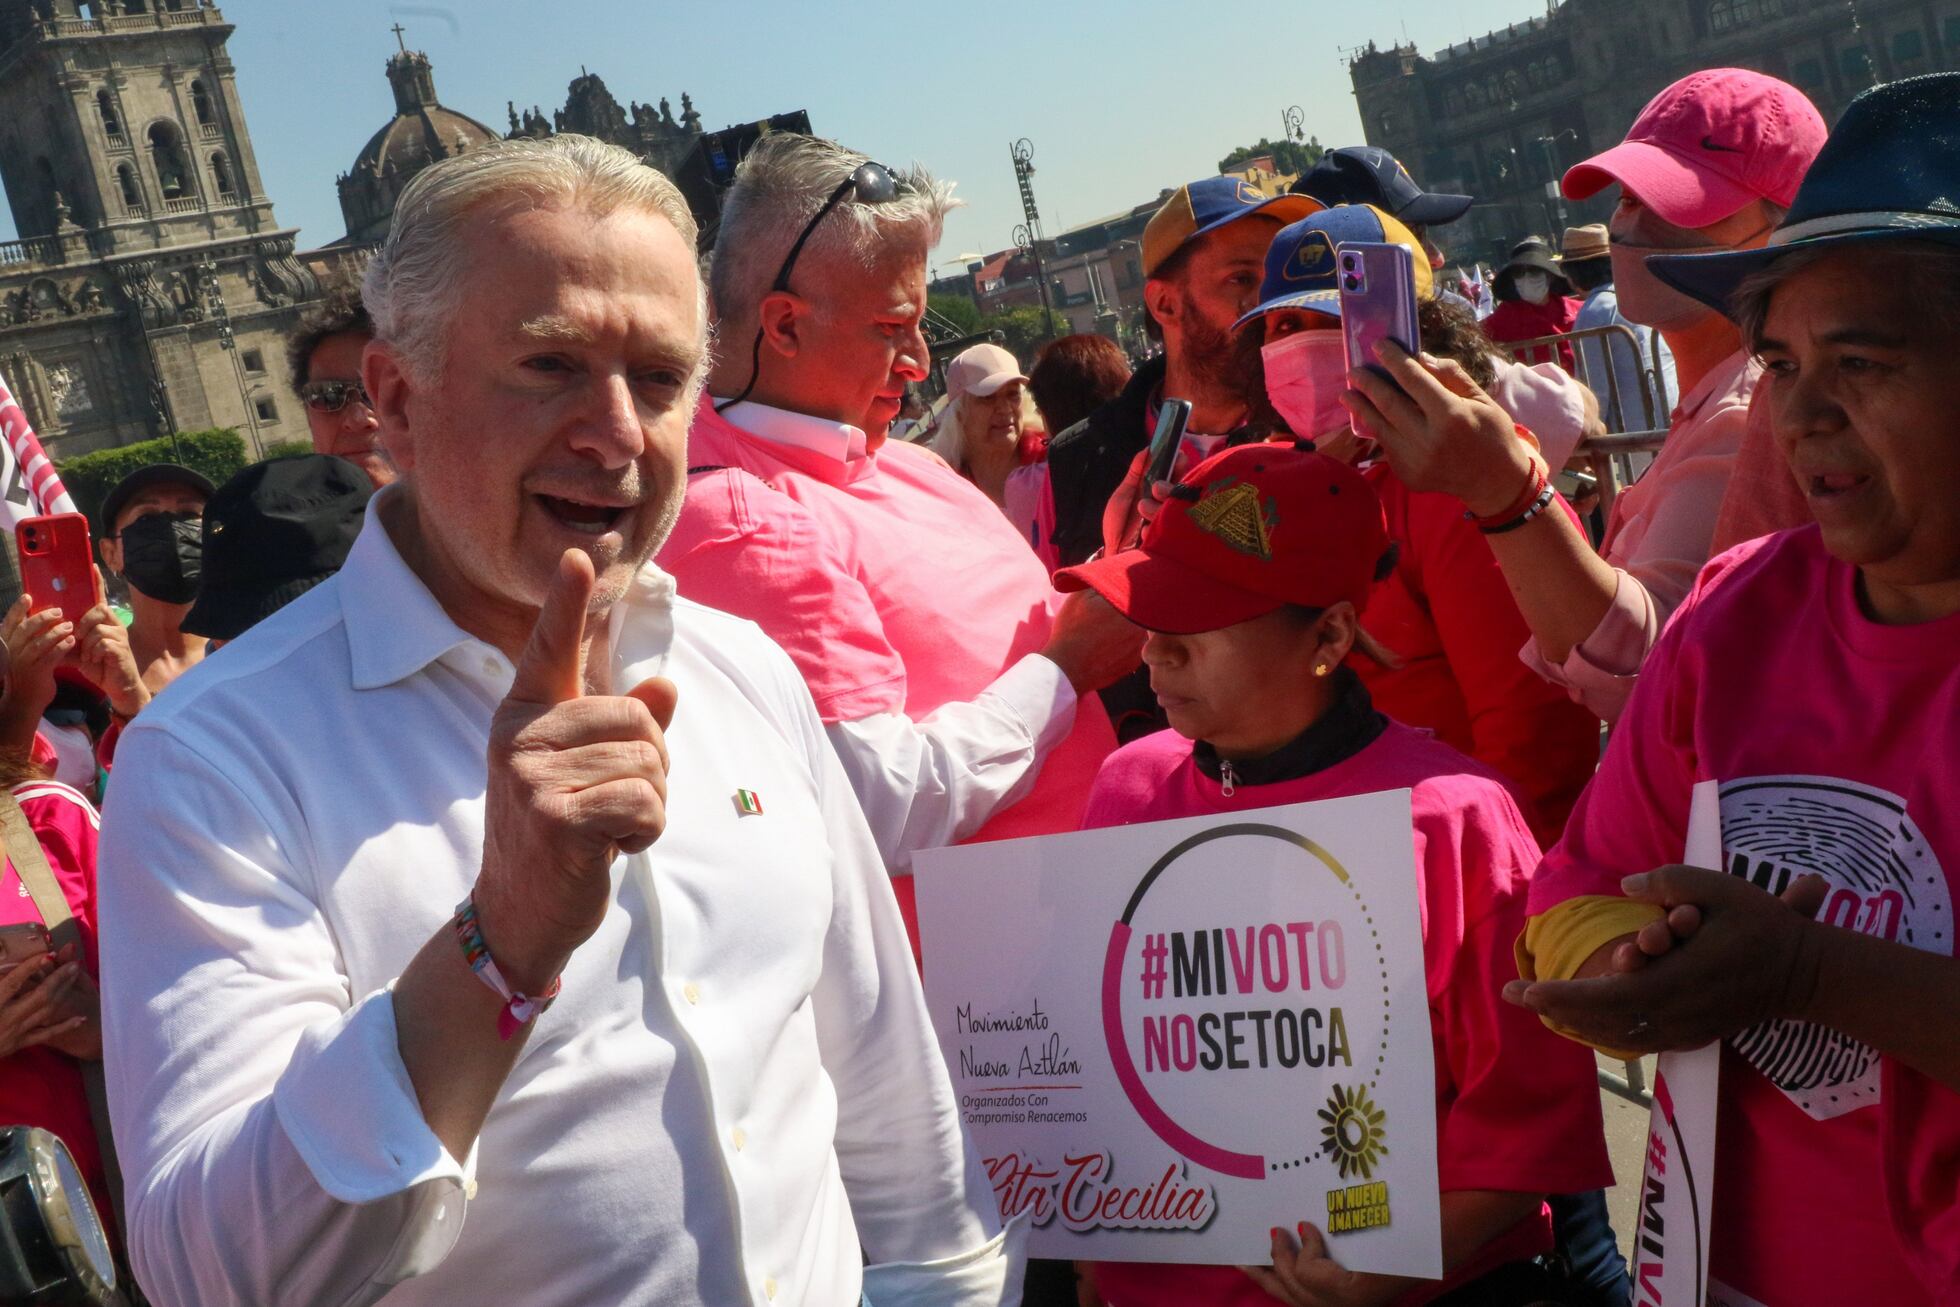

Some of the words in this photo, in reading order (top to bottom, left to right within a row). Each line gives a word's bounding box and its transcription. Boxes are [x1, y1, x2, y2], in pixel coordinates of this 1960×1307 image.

[1141, 920, 1347, 999] #MIVOTO
[956, 997, 1049, 1034] Movimiento
[960, 1045, 1011, 1079] Nueva
[1017, 1032, 1082, 1079] Aztlán
[1142, 1007, 1353, 1073] NOSETOCA
[962, 1094, 1026, 1111] Organizados
[1028, 1093, 1048, 1106] Con
[1028, 1110, 1087, 1123] Renacemos
[1061, 1152, 1208, 1223] Cecilia
[1326, 1189, 1345, 1212] UN
[1346, 1181, 1387, 1209] NUEVO
[1328, 1204, 1389, 1233] AMANECER
